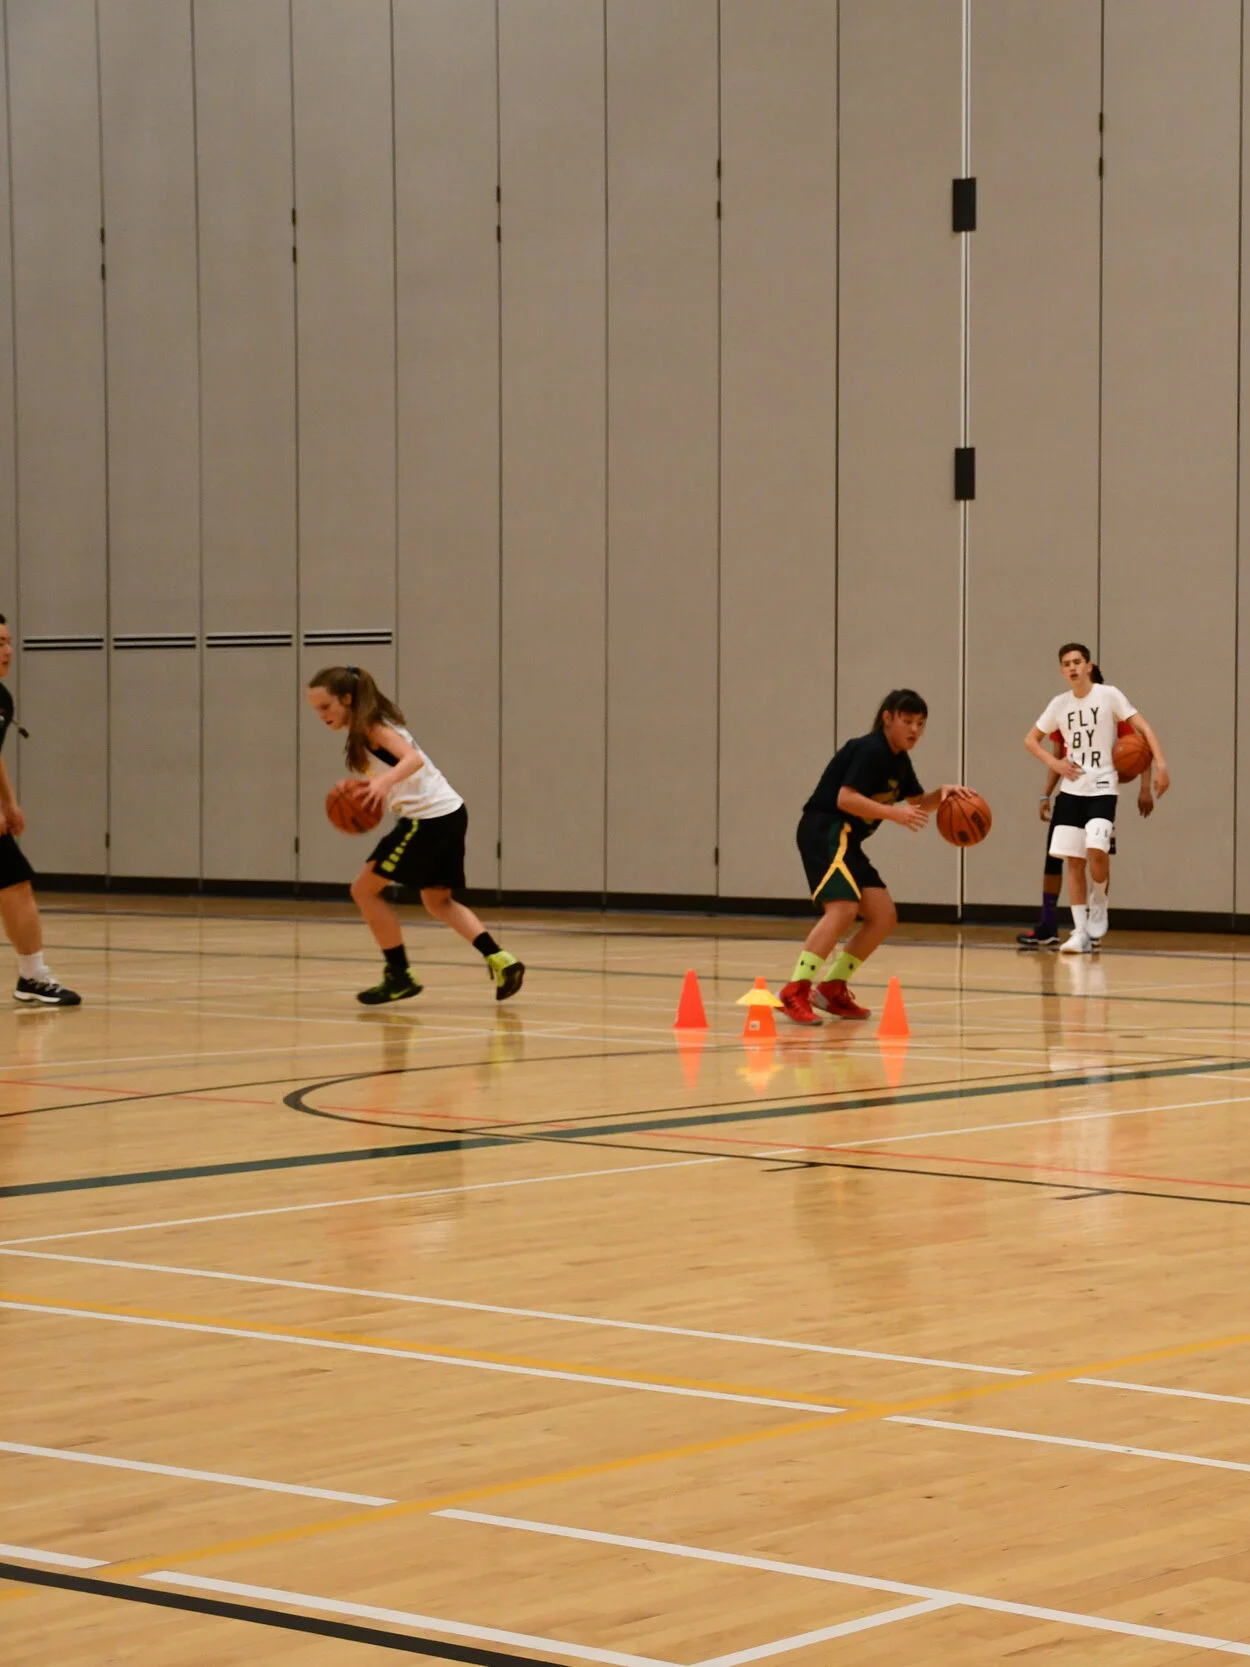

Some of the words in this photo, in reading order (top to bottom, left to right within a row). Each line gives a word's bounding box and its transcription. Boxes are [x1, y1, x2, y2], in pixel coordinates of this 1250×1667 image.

[1067, 706, 1099, 730] FLY
[1072, 729, 1095, 749] BY
[1070, 751, 1101, 768] IR
